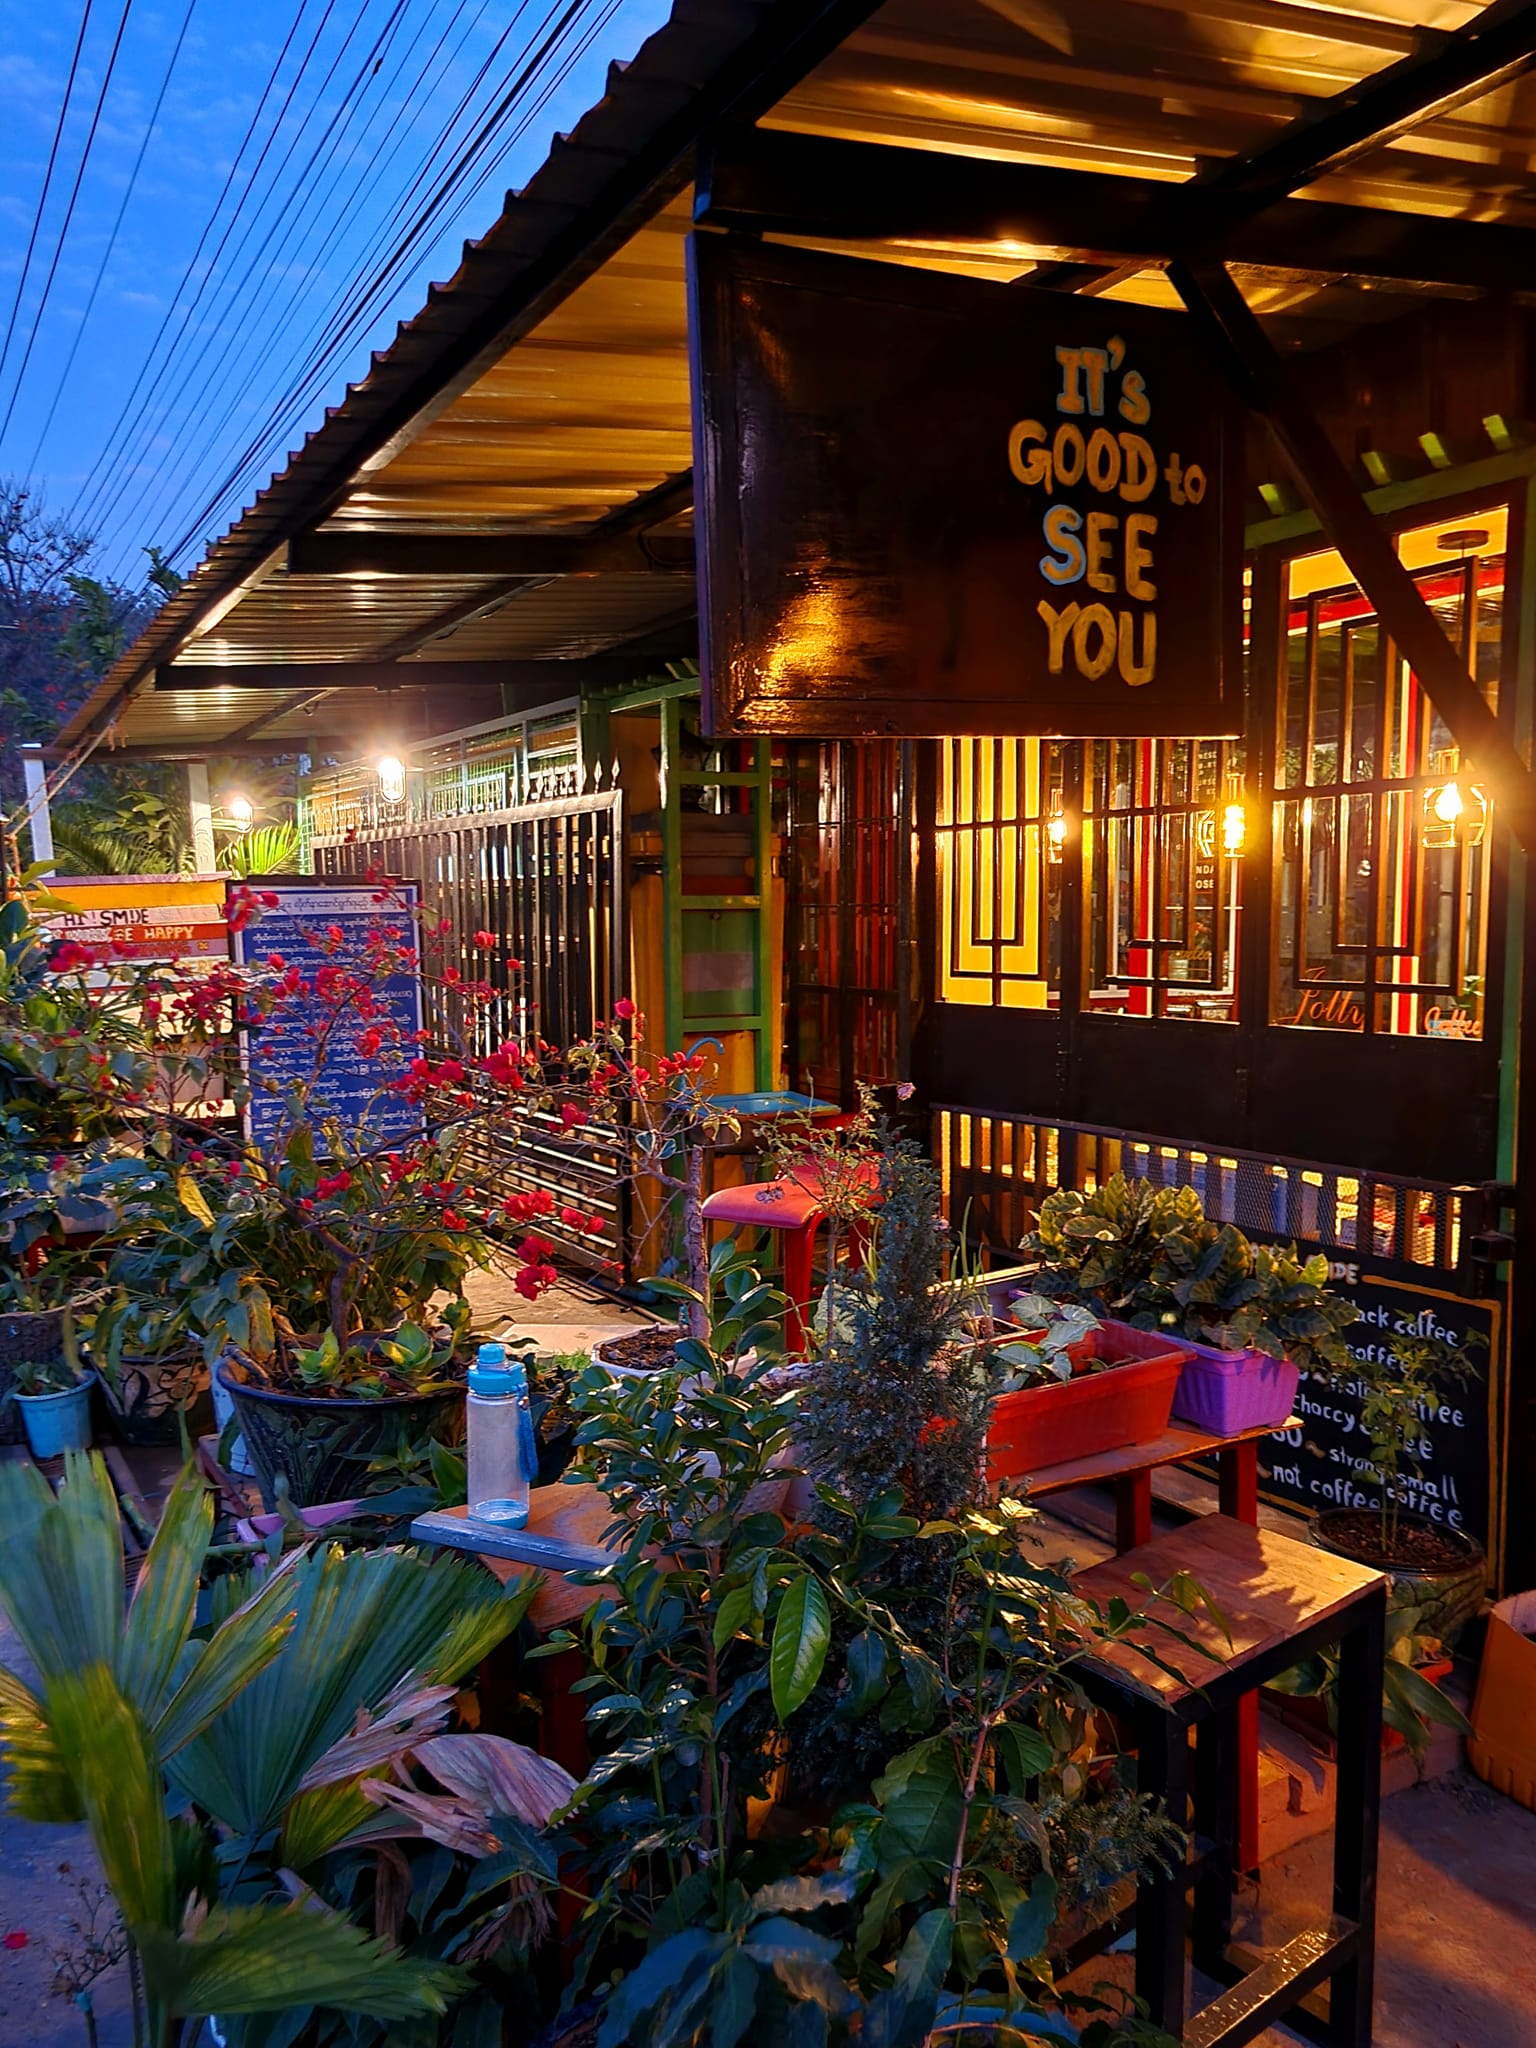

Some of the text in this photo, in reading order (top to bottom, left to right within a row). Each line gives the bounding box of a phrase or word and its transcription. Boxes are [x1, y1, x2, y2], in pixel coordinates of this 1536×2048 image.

[1008, 419, 1207, 505] GOOD to
[1039, 504, 1158, 601] SEE
[1036, 600, 1157, 686] YOU
[144, 926, 195, 939] HAPPY
[1394, 1311, 1460, 1347] coffee
[1273, 1463, 1382, 1508] not coffee
[1396, 1472, 1458, 1505] small
[1386, 1487, 1463, 1529] coffee
